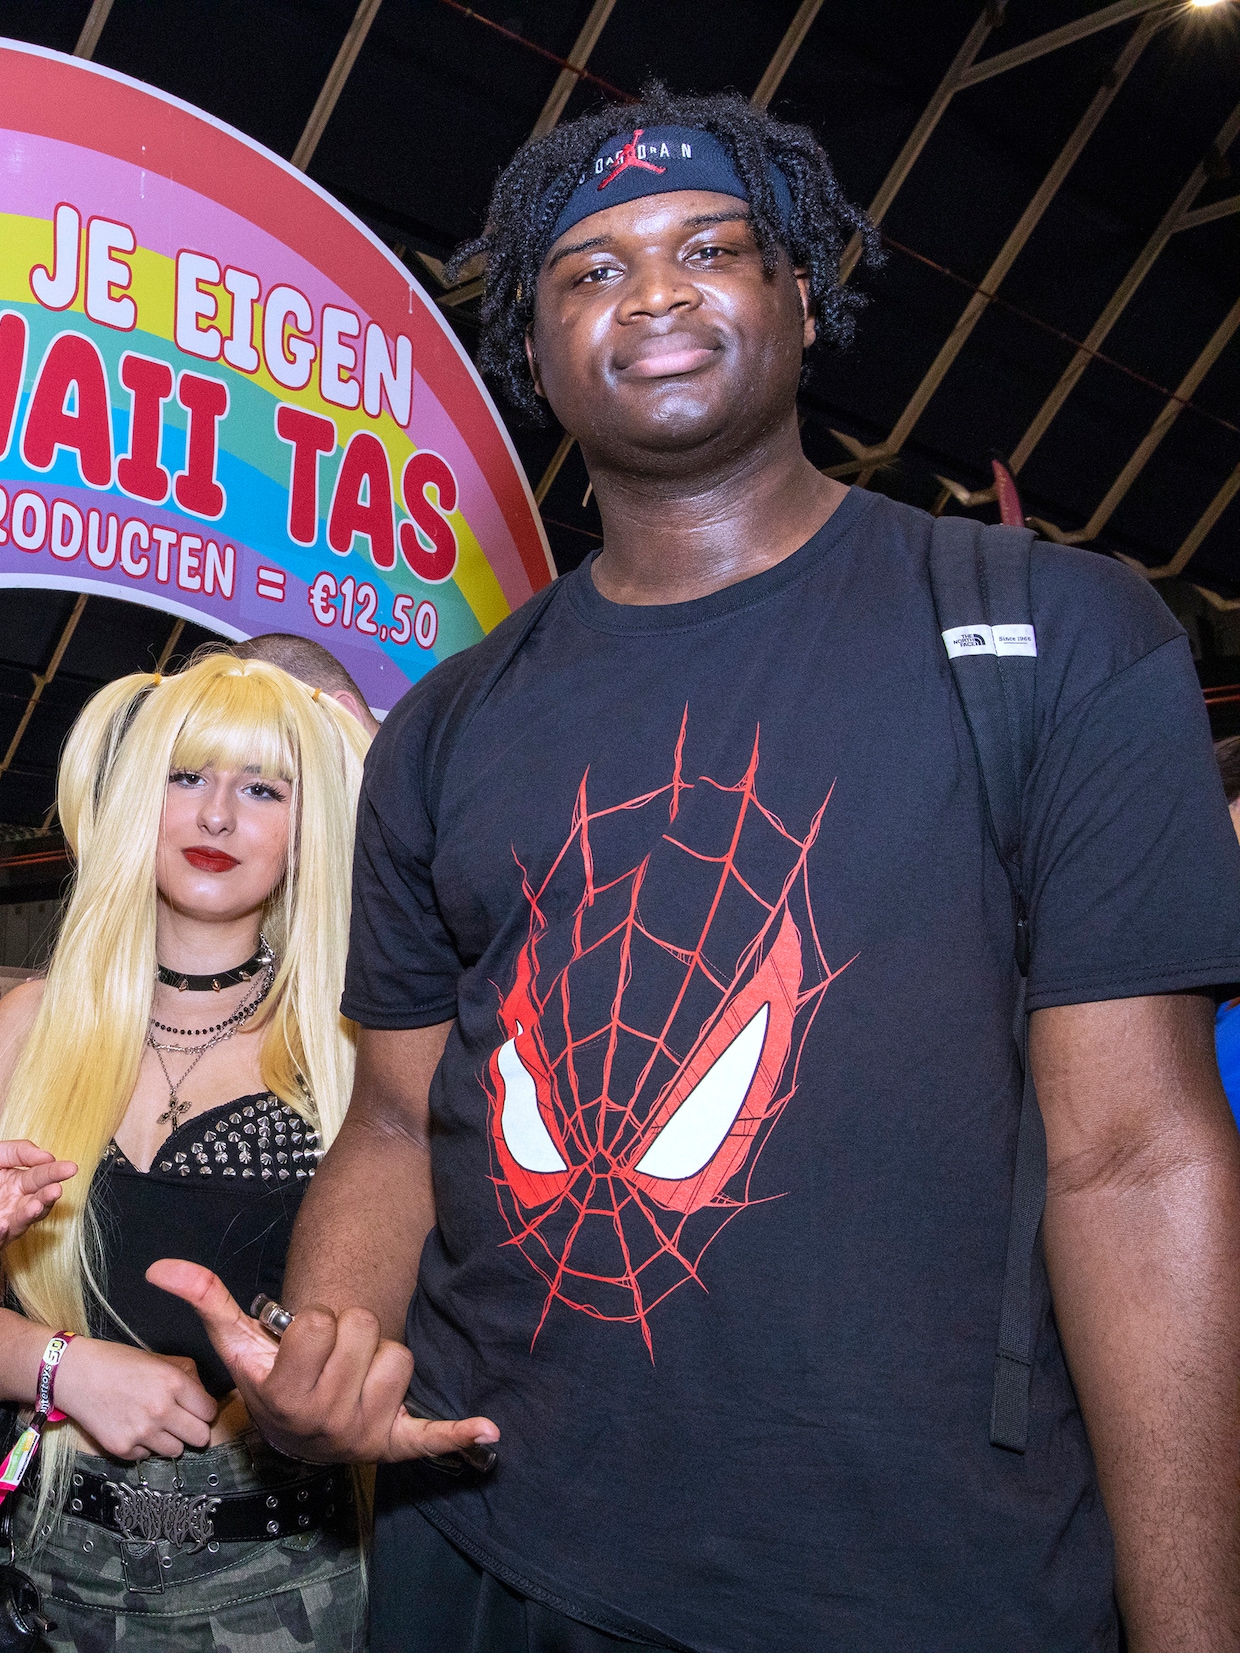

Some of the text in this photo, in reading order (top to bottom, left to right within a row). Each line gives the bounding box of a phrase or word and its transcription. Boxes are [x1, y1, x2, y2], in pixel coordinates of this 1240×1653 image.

[30, 202, 137, 331] JE
[173, 249, 413, 428] EIGEN
[274, 402, 460, 584] TAS
[257, 566, 286, 602] =
[309, 572, 439, 650] €12,50
